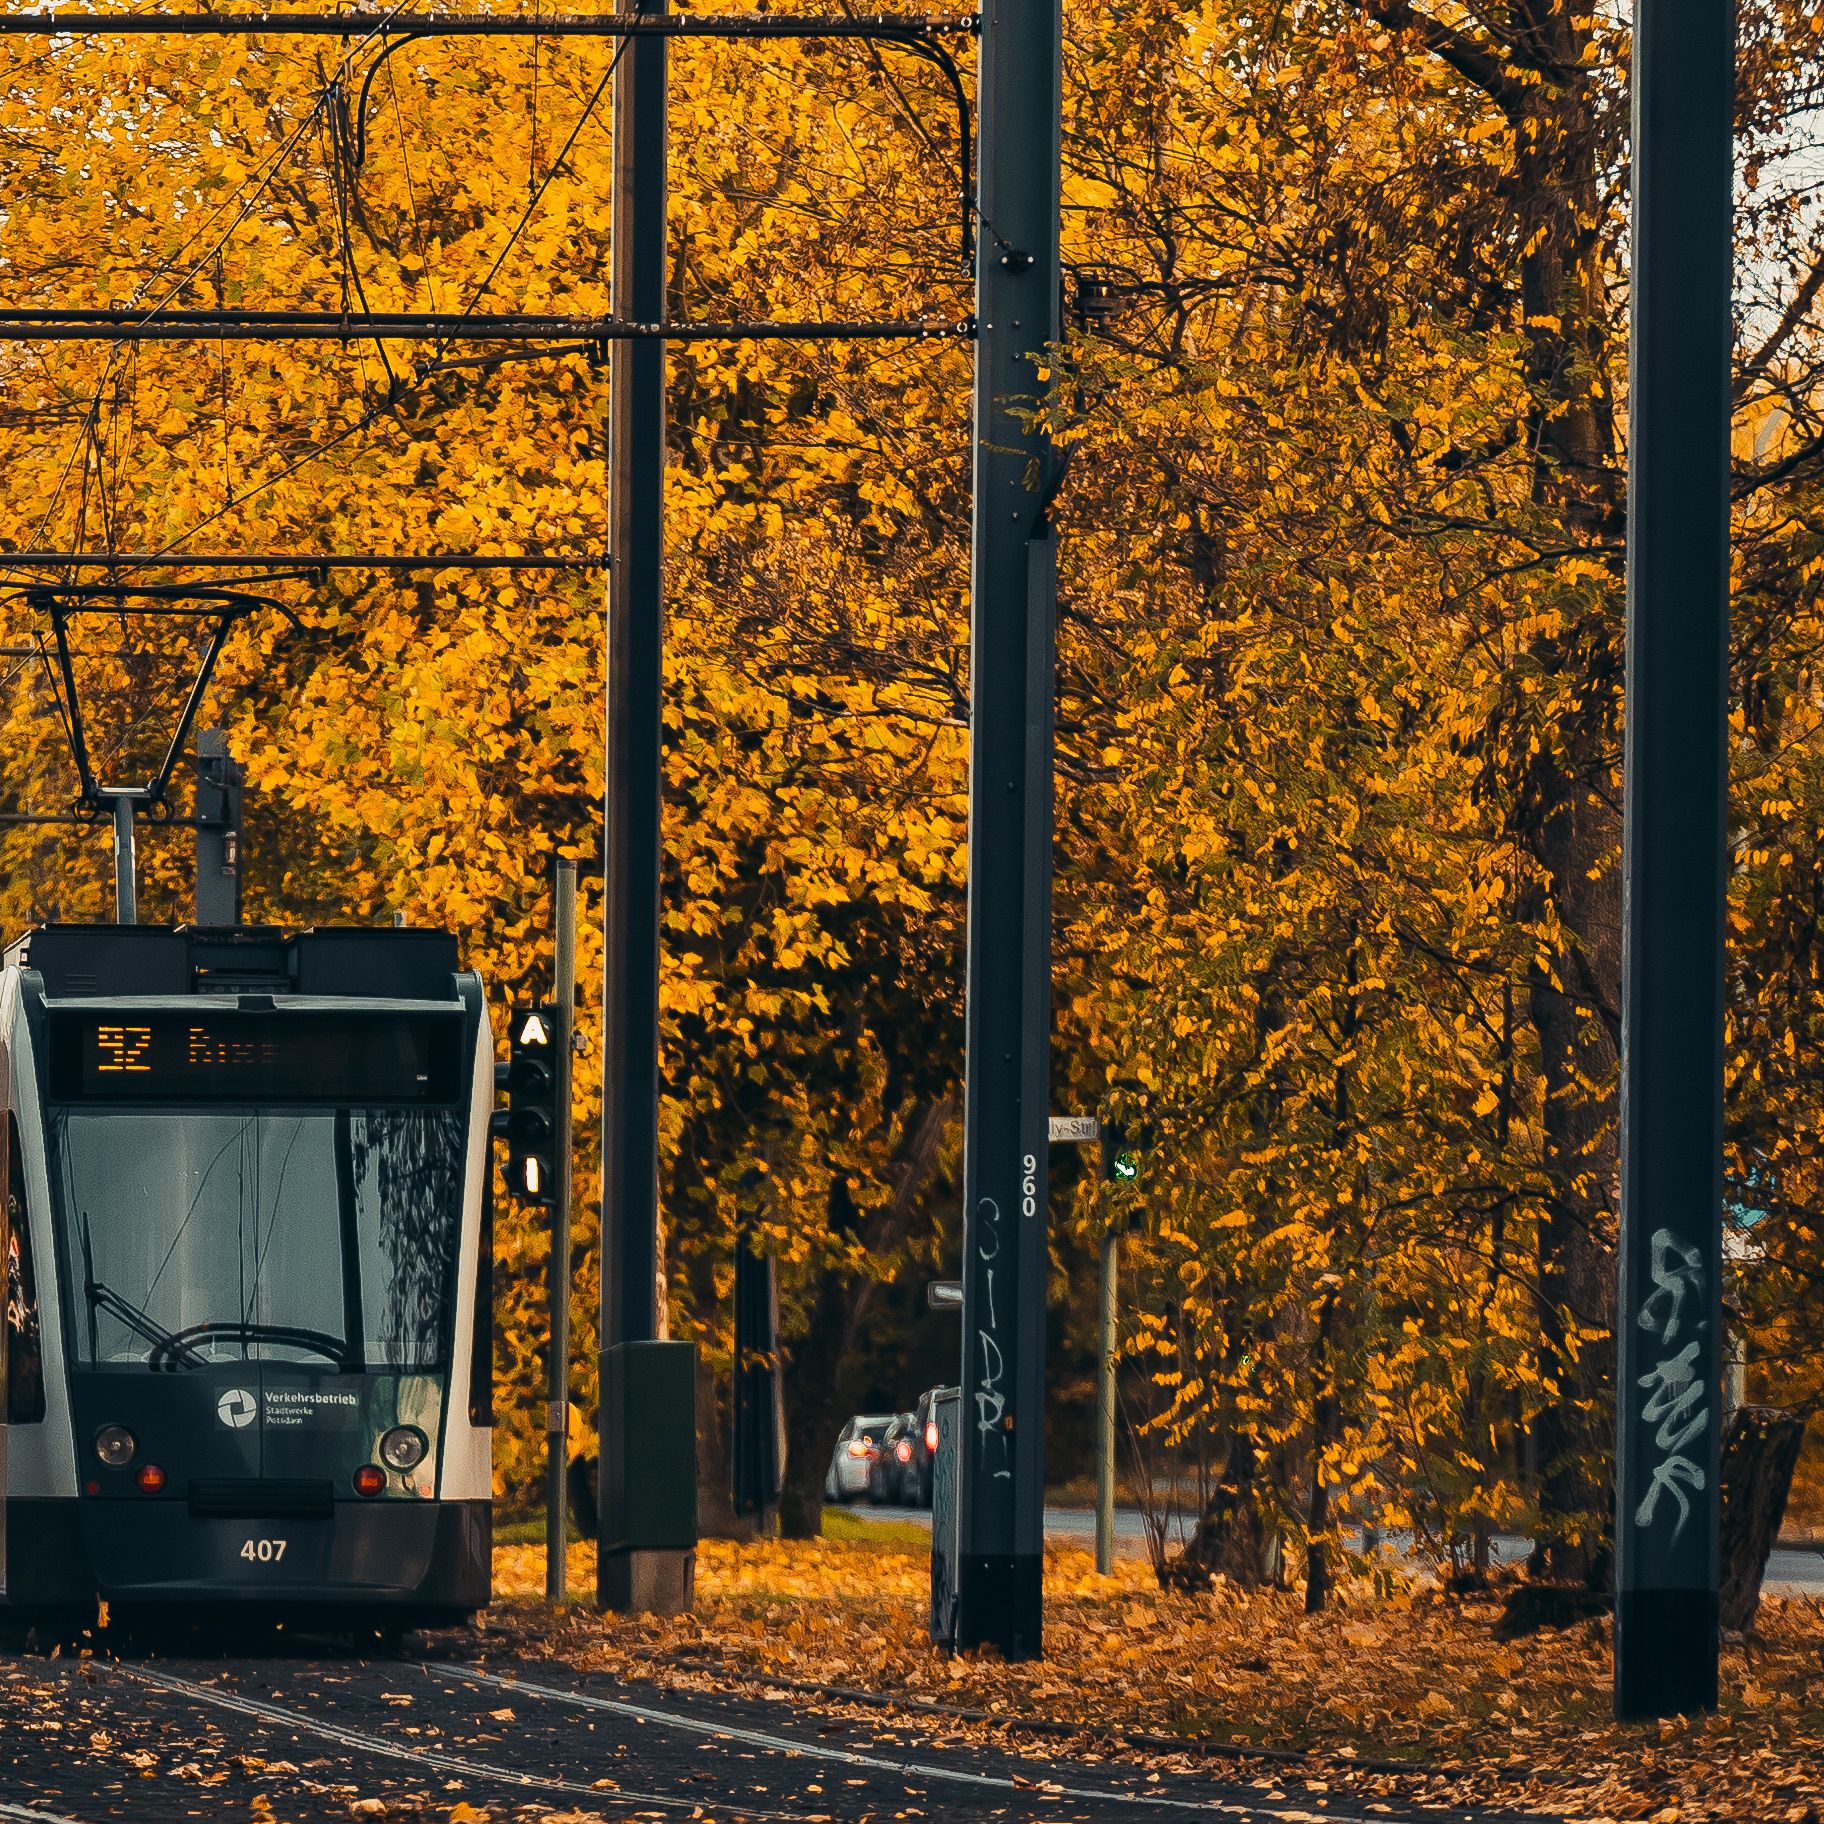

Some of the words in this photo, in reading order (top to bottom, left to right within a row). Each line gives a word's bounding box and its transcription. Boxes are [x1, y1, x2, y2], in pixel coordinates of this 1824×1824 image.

[1022, 1154, 1037, 1217] 960
[265, 1392, 357, 1405] Verkehrsbetrieb
[240, 1539, 287, 1562] 407
